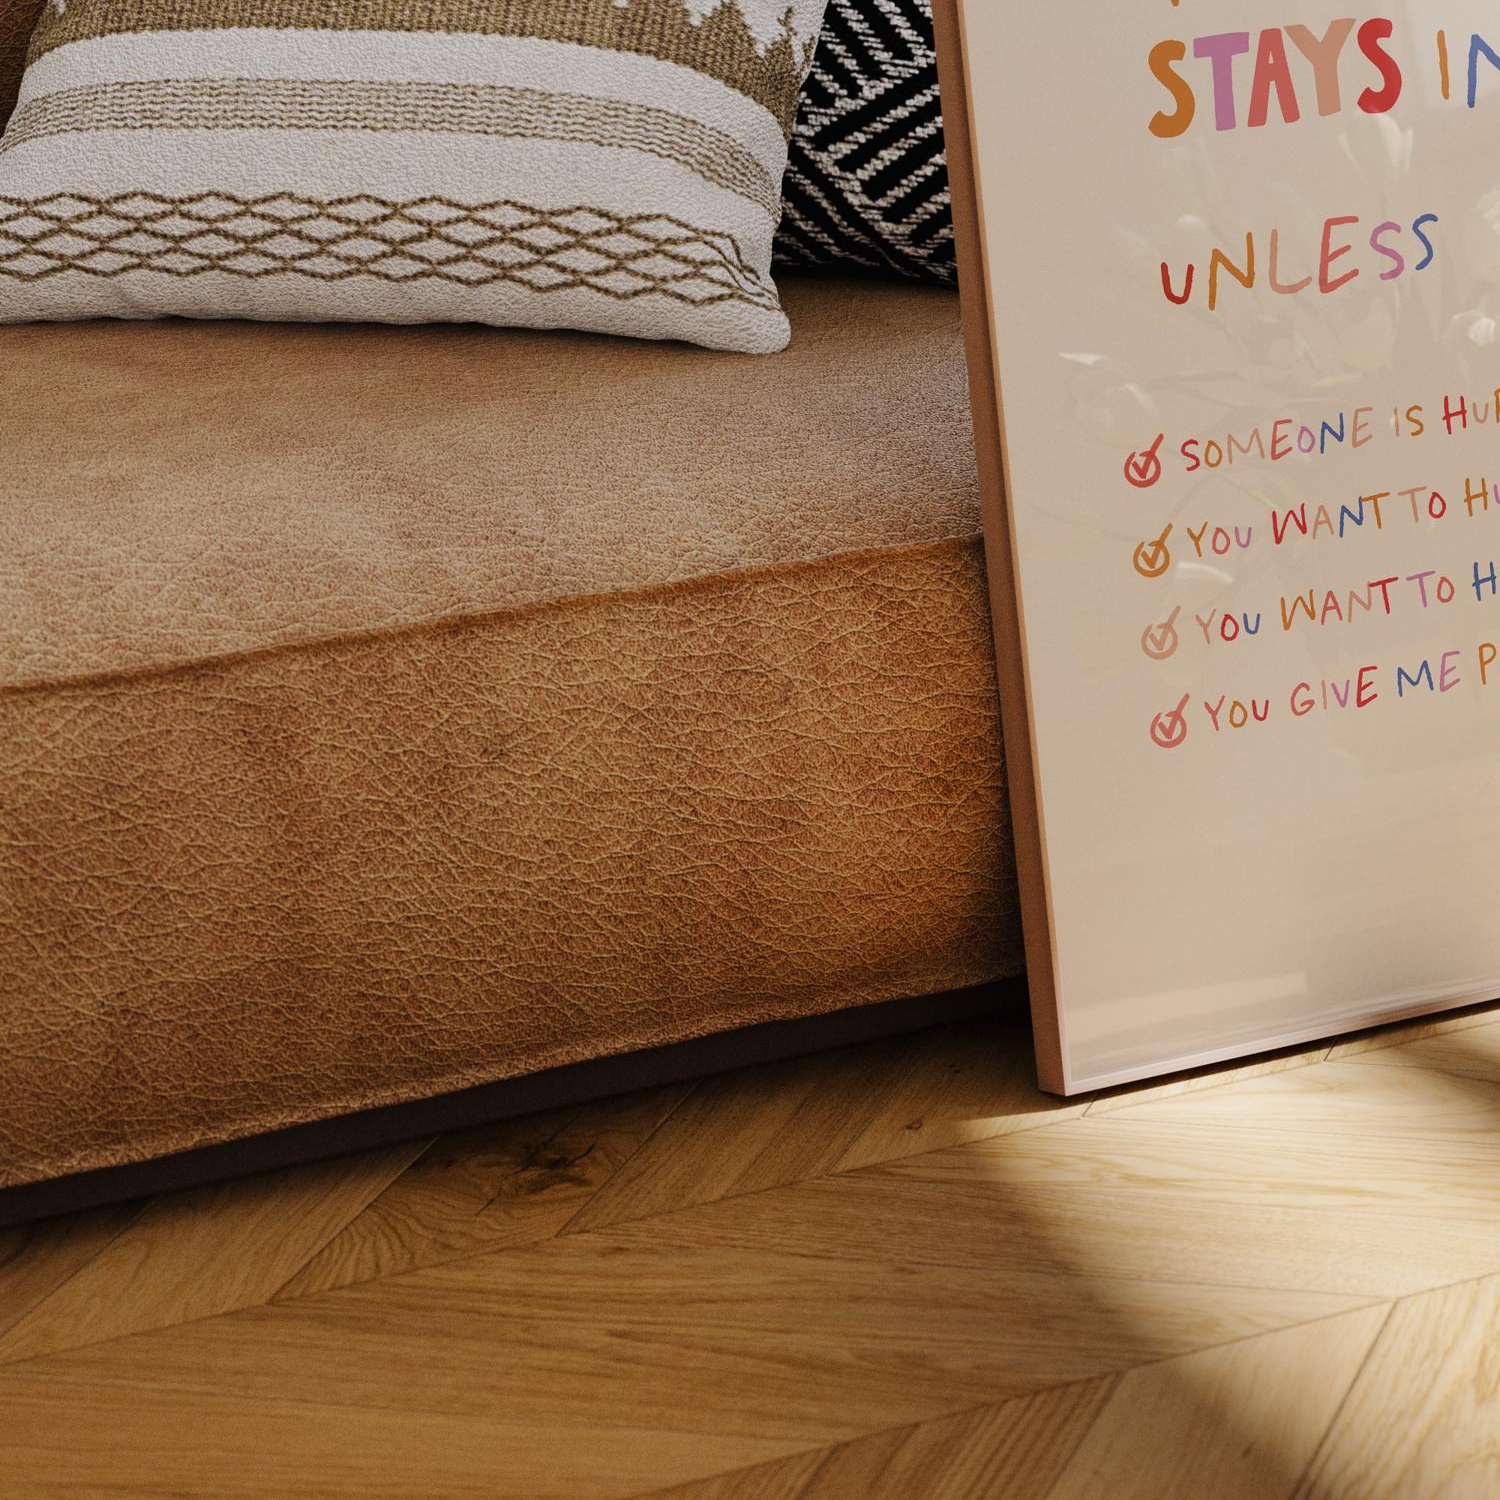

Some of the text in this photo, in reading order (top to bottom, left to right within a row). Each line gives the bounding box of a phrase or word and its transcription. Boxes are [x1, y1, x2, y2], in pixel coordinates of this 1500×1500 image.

[1148, 18, 1402, 138] STAYS
[1161, 214, 1438, 310] UNLESS
[1181, 406, 1373, 473] SOMEONE
[1394, 404, 1425, 438] IS
[1186, 522, 1253, 558] YOU
[1271, 491, 1391, 545] WANT
[1398, 485, 1447, 524] TO
[1195, 609, 1261, 645] YOU
[1279, 576, 1400, 632] WANT
[1406, 571, 1455, 609] TO
[1204, 695, 1269, 732] YOU
[1289, 666, 1378, 718] GIVE
[1396, 650, 1462, 697] ME
